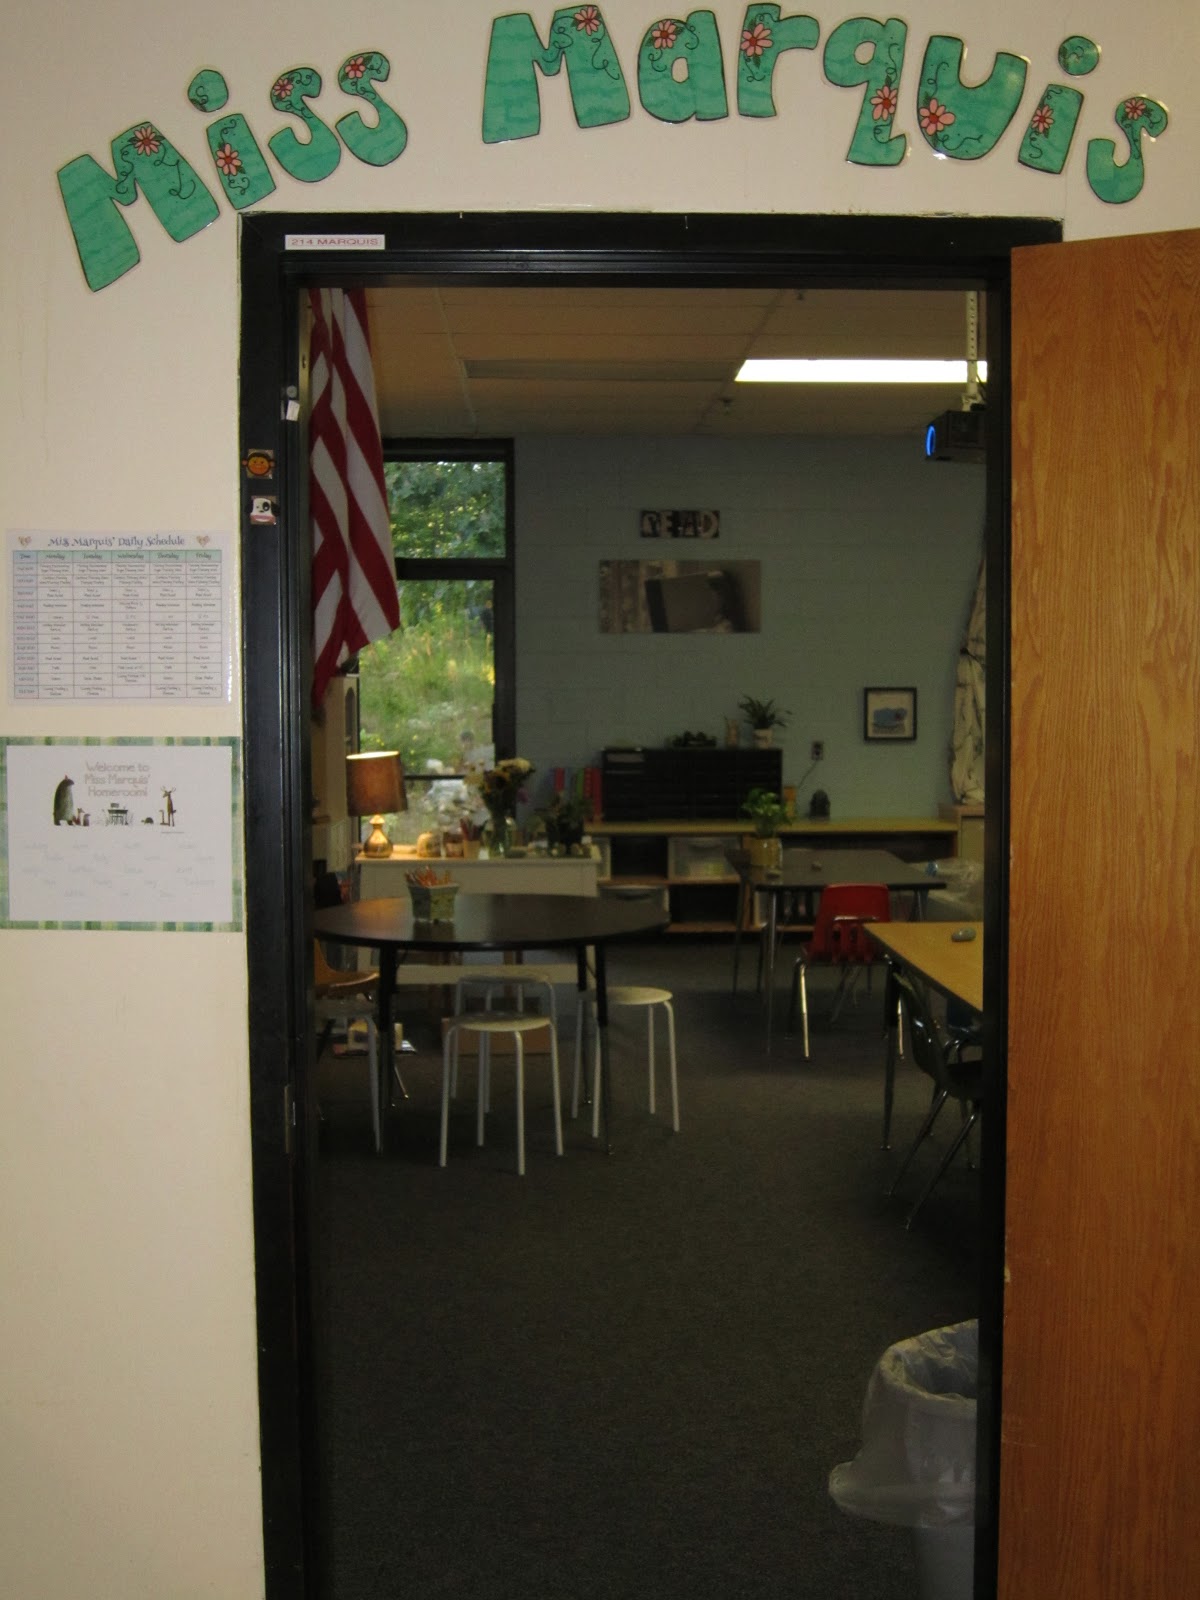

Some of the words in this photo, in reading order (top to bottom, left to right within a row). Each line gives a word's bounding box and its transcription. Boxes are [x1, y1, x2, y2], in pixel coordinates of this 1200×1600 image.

[57, 51, 408, 292] Miss
[291, 238, 313, 246] 214
[317, 238, 378, 246] MARQUIS
[118, 536, 144, 549] Daily
[145, 534, 185, 547] Schedule
[85, 760, 136, 772] Welcome
[138, 763, 150, 772] to
[84, 774, 106, 784] Miss
